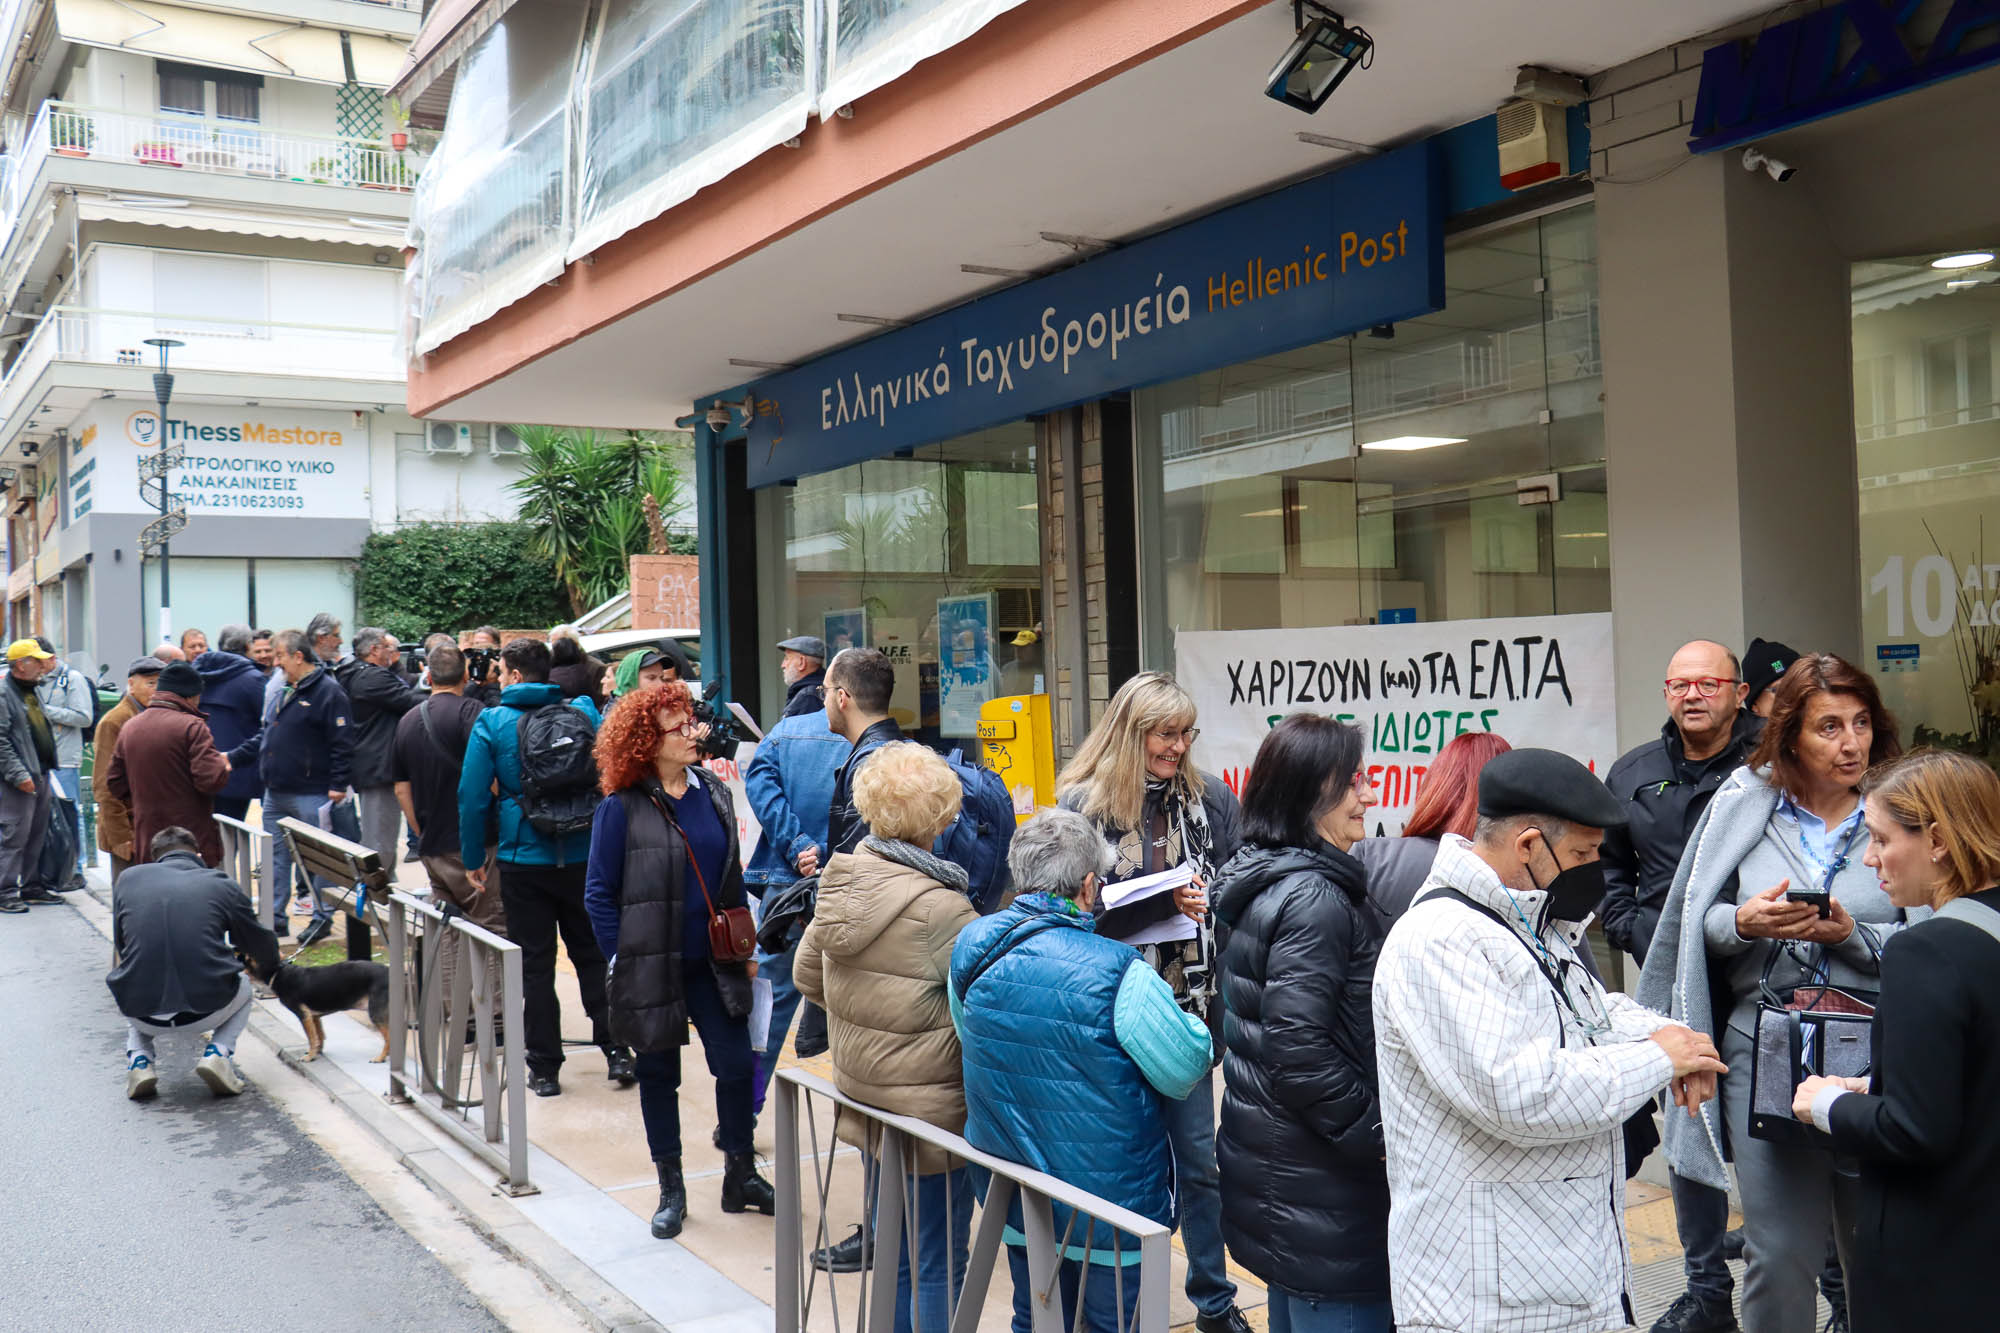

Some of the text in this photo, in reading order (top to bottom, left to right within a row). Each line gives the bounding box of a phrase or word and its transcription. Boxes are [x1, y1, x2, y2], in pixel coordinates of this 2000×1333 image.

[1208, 219, 1408, 312] Hellenic Post
[822, 272, 1190, 430] Ελληνικά Ταχυδρομεία
[166, 419, 343, 446] ThessMastora
[179, 475, 297, 491] ΑΝΑΚΑΙΝΙΣΕΙΣ
[287, 460, 335, 474] ΥΛΙΚΟ
[1871, 555, 1957, 637] 10
[1227, 658, 1371, 707] ΧΑΡΙΖΟΥΝ
[1423, 652, 1460, 696] ΤΑ
[978, 723, 996, 737] Post
